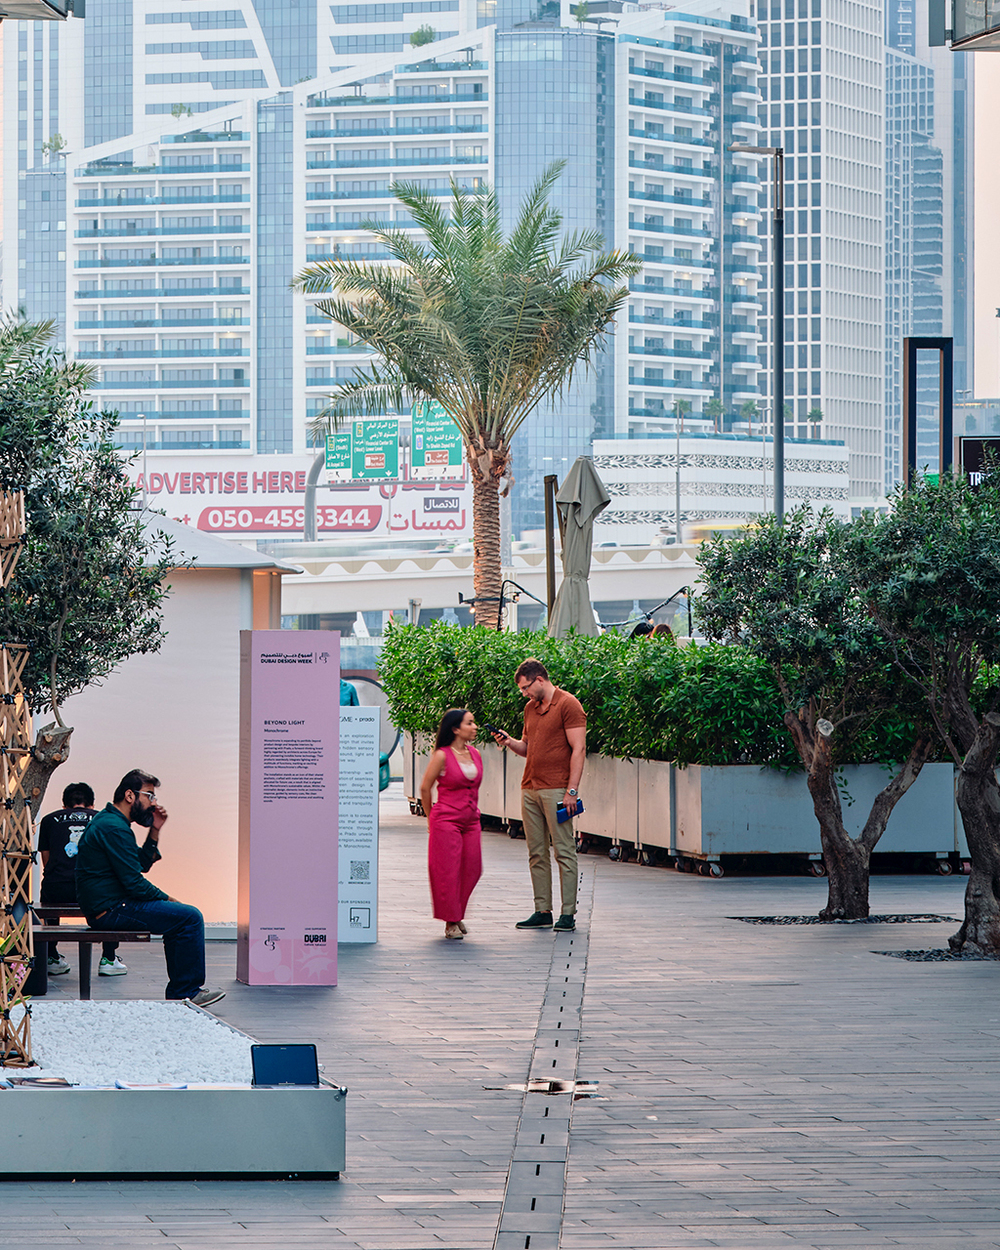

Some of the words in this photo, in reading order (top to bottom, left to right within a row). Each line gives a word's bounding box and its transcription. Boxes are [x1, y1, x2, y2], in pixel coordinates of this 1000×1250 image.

[136, 471, 249, 495] ADVERTISE
[251, 470, 307, 494] HERE
[424, 498, 459, 512] للاتصال
[386, 508, 467, 531] لمسات
[304, 934, 327, 943] DUBAI
